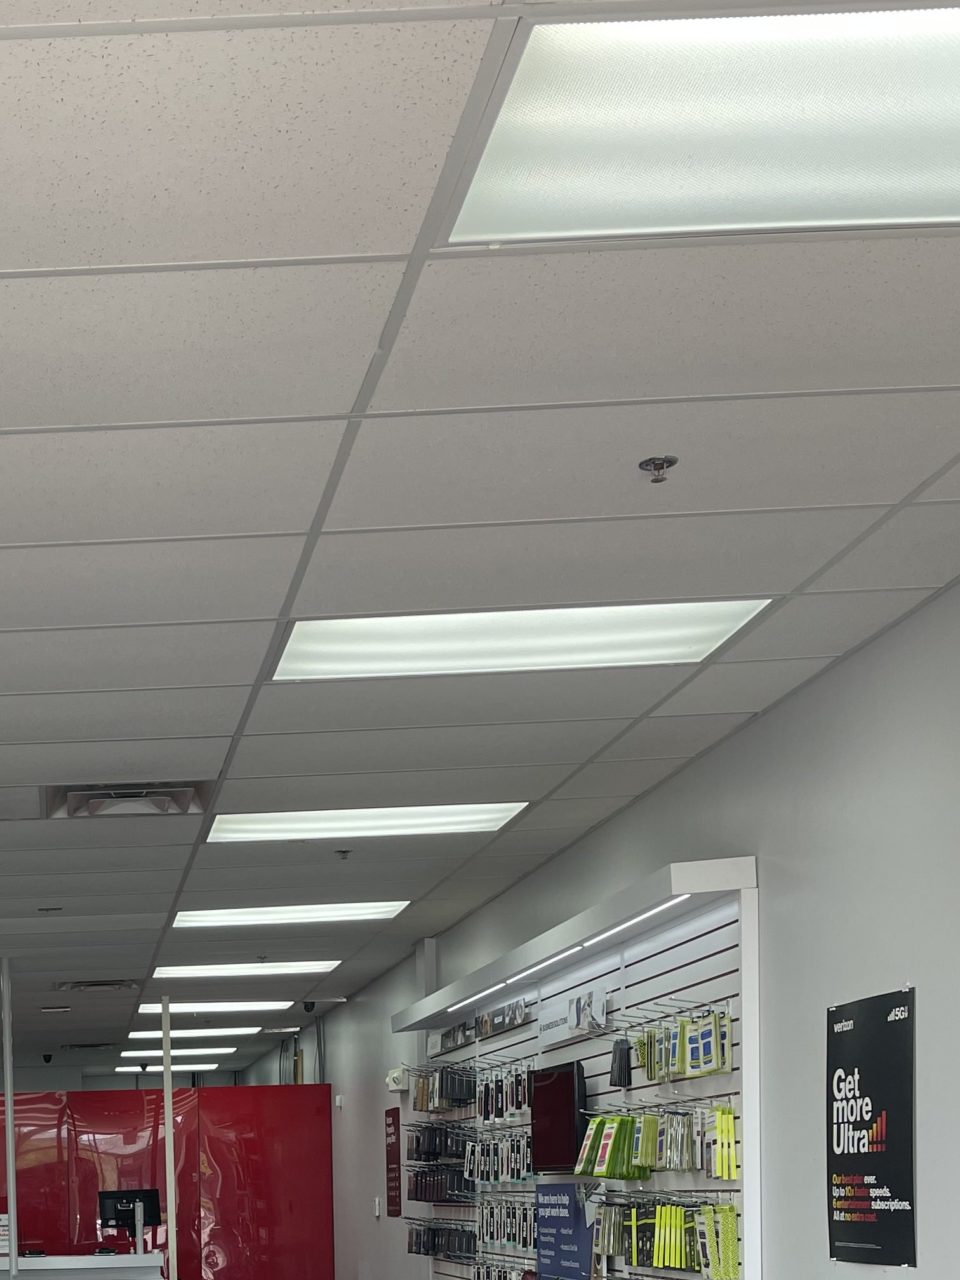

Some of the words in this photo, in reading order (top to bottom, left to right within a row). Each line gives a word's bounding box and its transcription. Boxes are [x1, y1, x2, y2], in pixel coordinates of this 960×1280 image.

[894, 1006, 905, 1021] 5G
[833, 1018, 855, 1034] verizon
[832, 1066, 860, 1100] Get
[832, 1096, 873, 1124] more
[832, 1122, 870, 1155] Ultra
[869, 1185, 892, 1199] speeds.
[871, 1198, 912, 1212] subscriptions.
